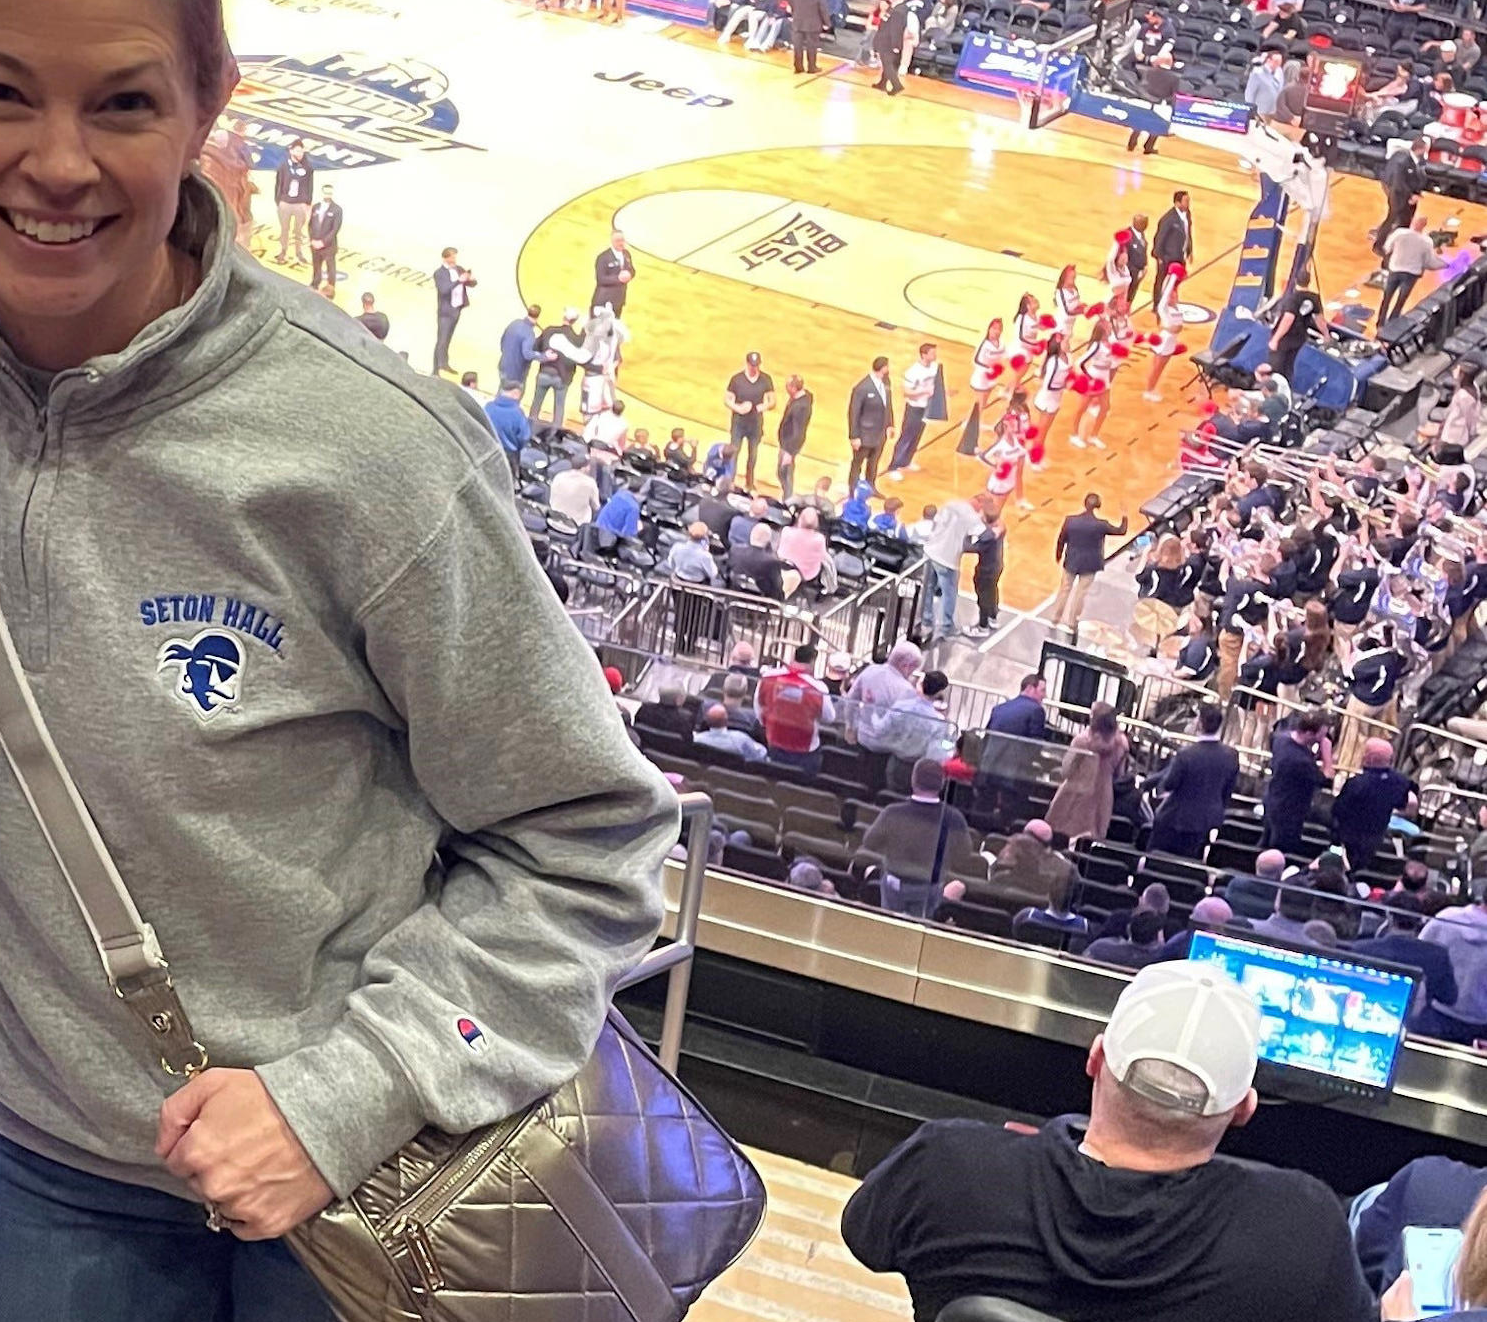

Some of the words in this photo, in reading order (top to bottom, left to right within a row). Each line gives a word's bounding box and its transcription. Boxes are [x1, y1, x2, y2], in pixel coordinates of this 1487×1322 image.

[593, 70, 734, 108] Jeep
[139, 593, 216, 626] SETON
[221, 596, 286, 650] HALL
